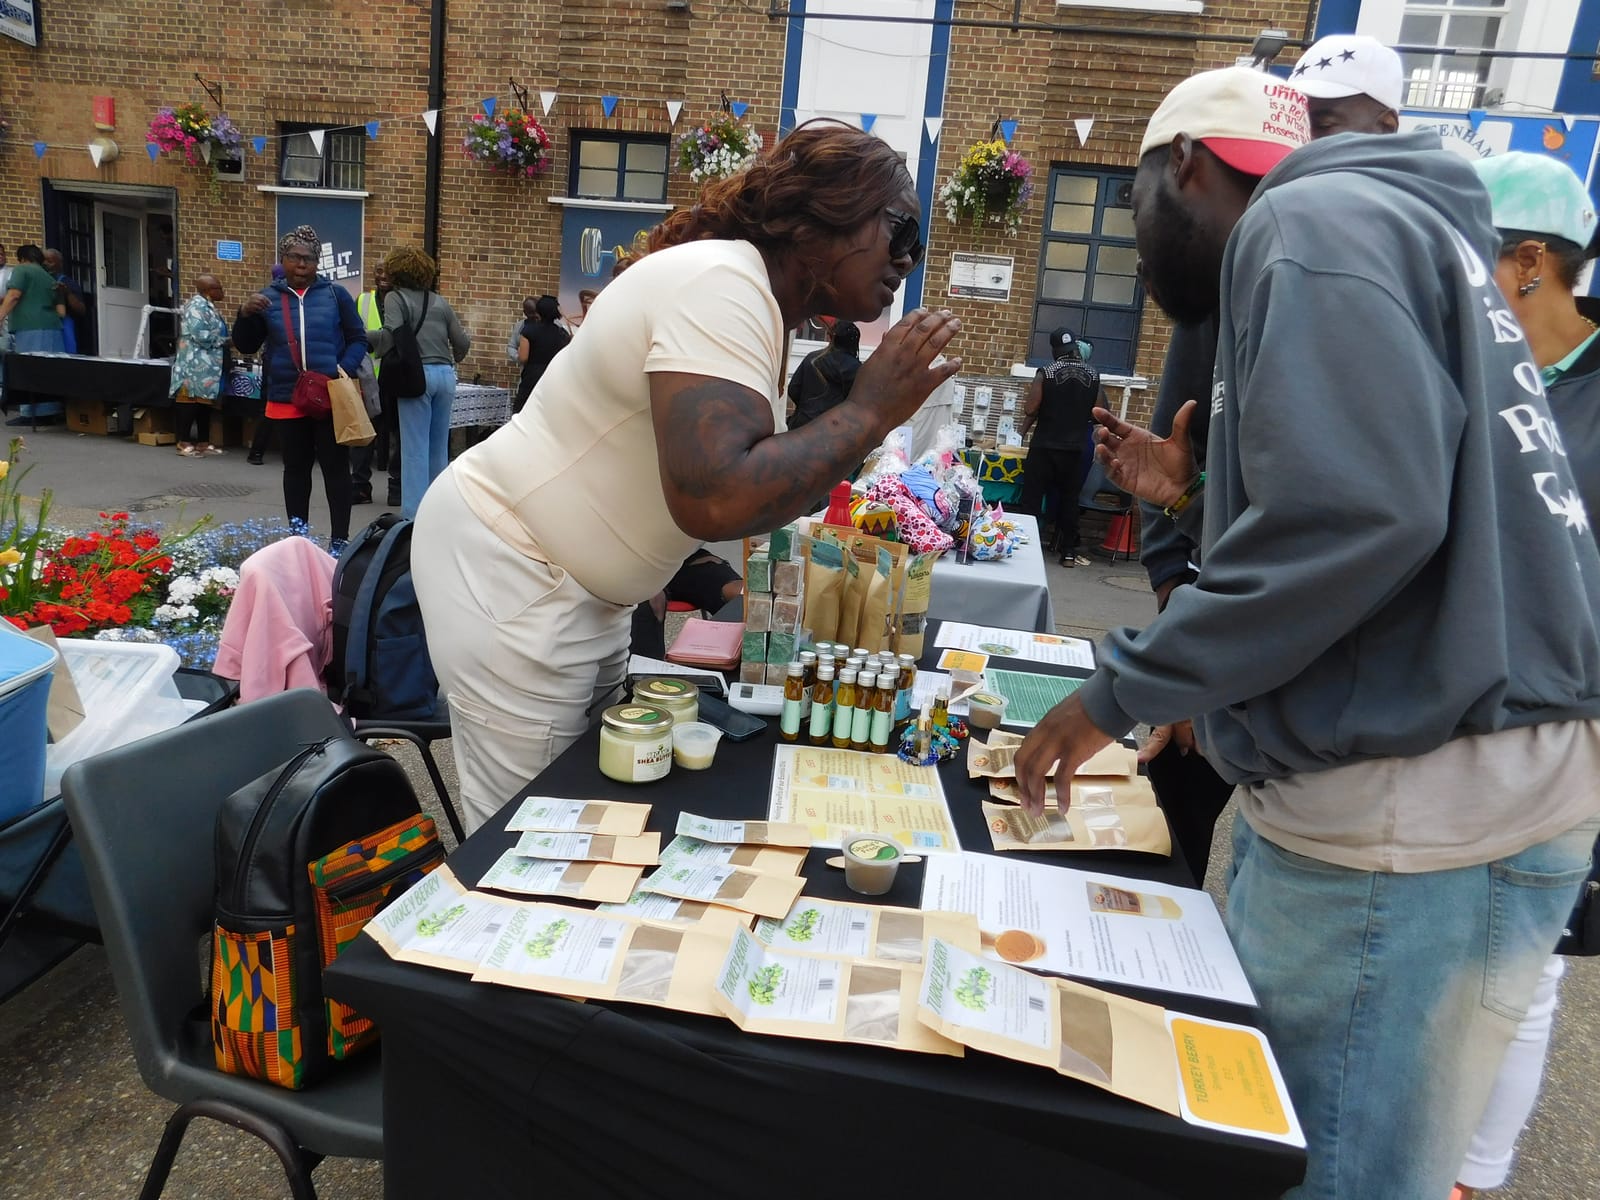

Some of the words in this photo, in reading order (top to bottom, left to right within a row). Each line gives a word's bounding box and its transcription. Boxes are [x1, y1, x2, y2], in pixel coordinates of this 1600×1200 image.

[1269, 98, 1278, 110] is
[1279, 103, 1286, 112] a
[1270, 110, 1283, 122] of
[1432, 123, 1497, 159] ENHAM
[337, 250, 353, 266] IT
[1483, 296, 1524, 343] is
[1512, 361, 1547, 397] o
[637, 757, 655, 765] SHEA
[380, 895, 416, 933] TURKEY
[413, 873, 440, 906] BERRY
[486, 930, 517, 969] TURKEY
[508, 906, 531, 936] BERRY
[721, 958, 741, 1001] TURKEY
[733, 929, 750, 966] BERRY
[933, 938, 948, 975] BERRY
[927, 966, 944, 1015] TURKEY
[1183, 1031, 1200, 1063] BERRY
[1189, 1064, 1208, 1103] TURKEY
